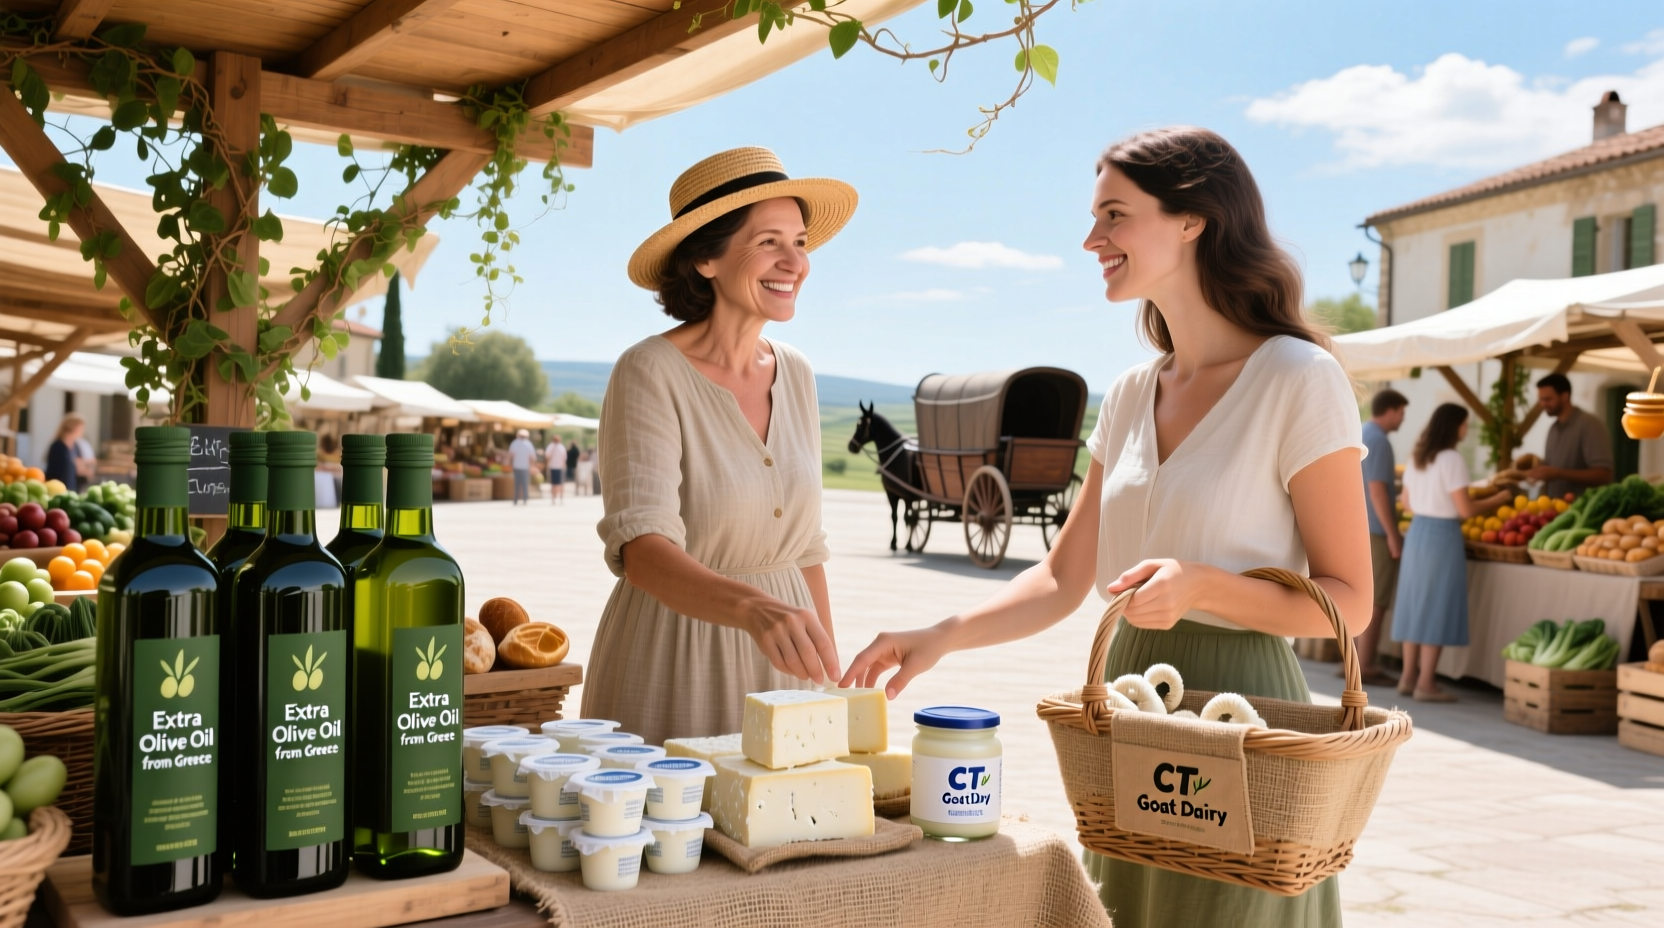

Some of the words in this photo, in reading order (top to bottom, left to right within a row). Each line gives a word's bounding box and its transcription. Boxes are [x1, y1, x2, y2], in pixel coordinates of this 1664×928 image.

[409, 692, 449, 708] Extra
[153, 711, 202, 730] Extra
[285, 704, 329, 721] Extra
[397, 712, 436, 730] Olive
[440, 708, 459, 726] Oil
[139, 733, 188, 752] Olive
[190, 728, 214, 748] Oil
[272, 725, 316, 744] Olive
[320, 720, 341, 739] Oil
[142, 755, 172, 770] from
[275, 746, 302, 760] from
[948, 766, 985, 790] CT
[1154, 762, 1198, 796] CT
[942, 792, 970, 804] Goat
[1137, 794, 1177, 816] Goat
[1181, 800, 1227, 826] Dairy
